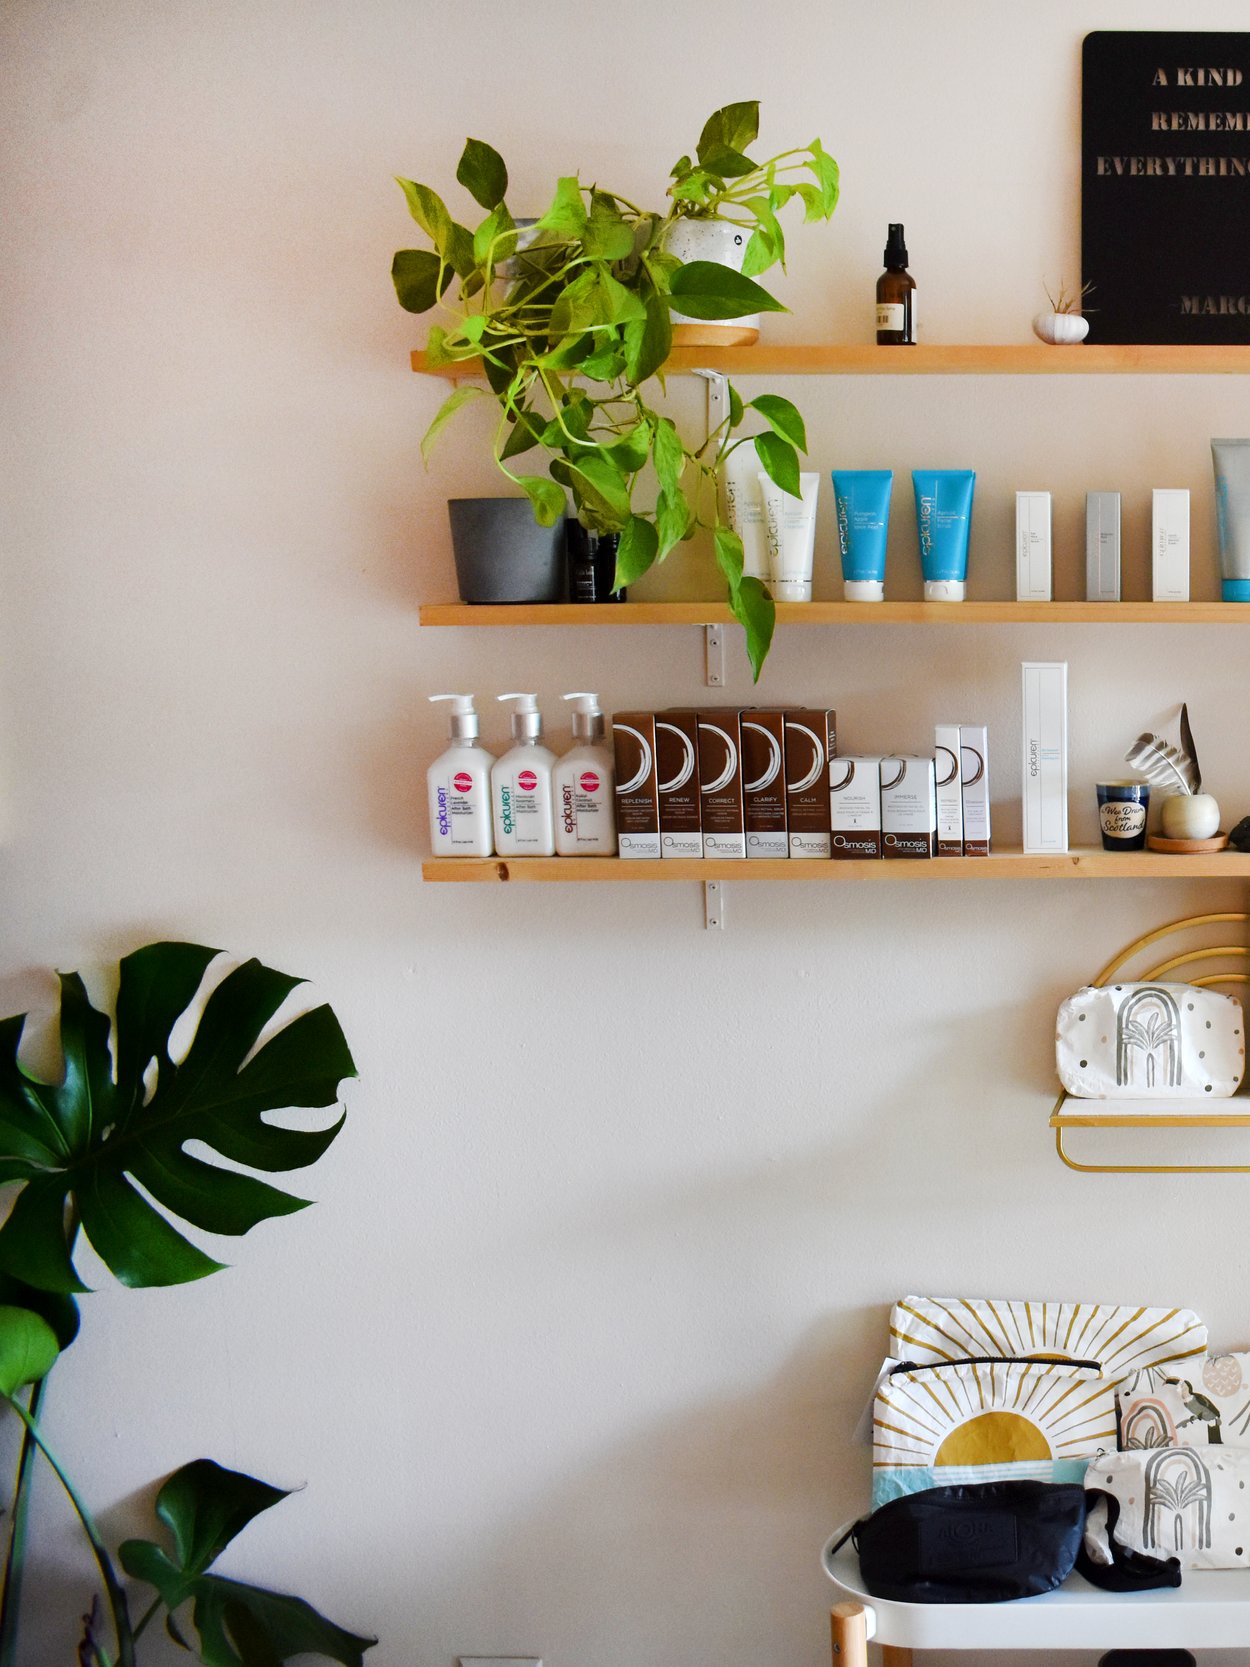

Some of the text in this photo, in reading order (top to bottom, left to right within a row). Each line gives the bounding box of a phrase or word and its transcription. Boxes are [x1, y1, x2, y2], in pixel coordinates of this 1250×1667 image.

[1152, 68, 1168, 86] A
[1177, 69, 1243, 87] KIND
[920, 496, 936, 556] epicuren
[1028, 739, 1041, 776] epicuren
[437, 787, 452, 835] epicuren
[501, 786, 515, 834] epicuren
[561, 785, 576, 833] epicuren
[1104, 819, 1145, 831] Scotland
[1115, 815, 1131, 824] from
[621, 837, 658, 849] Osmosis
[663, 836, 700, 848] Osmosis
[705, 837, 743, 849] Osmosis
[748, 836, 786, 848] Osmosis
[791, 836, 828, 849] Osmosis
